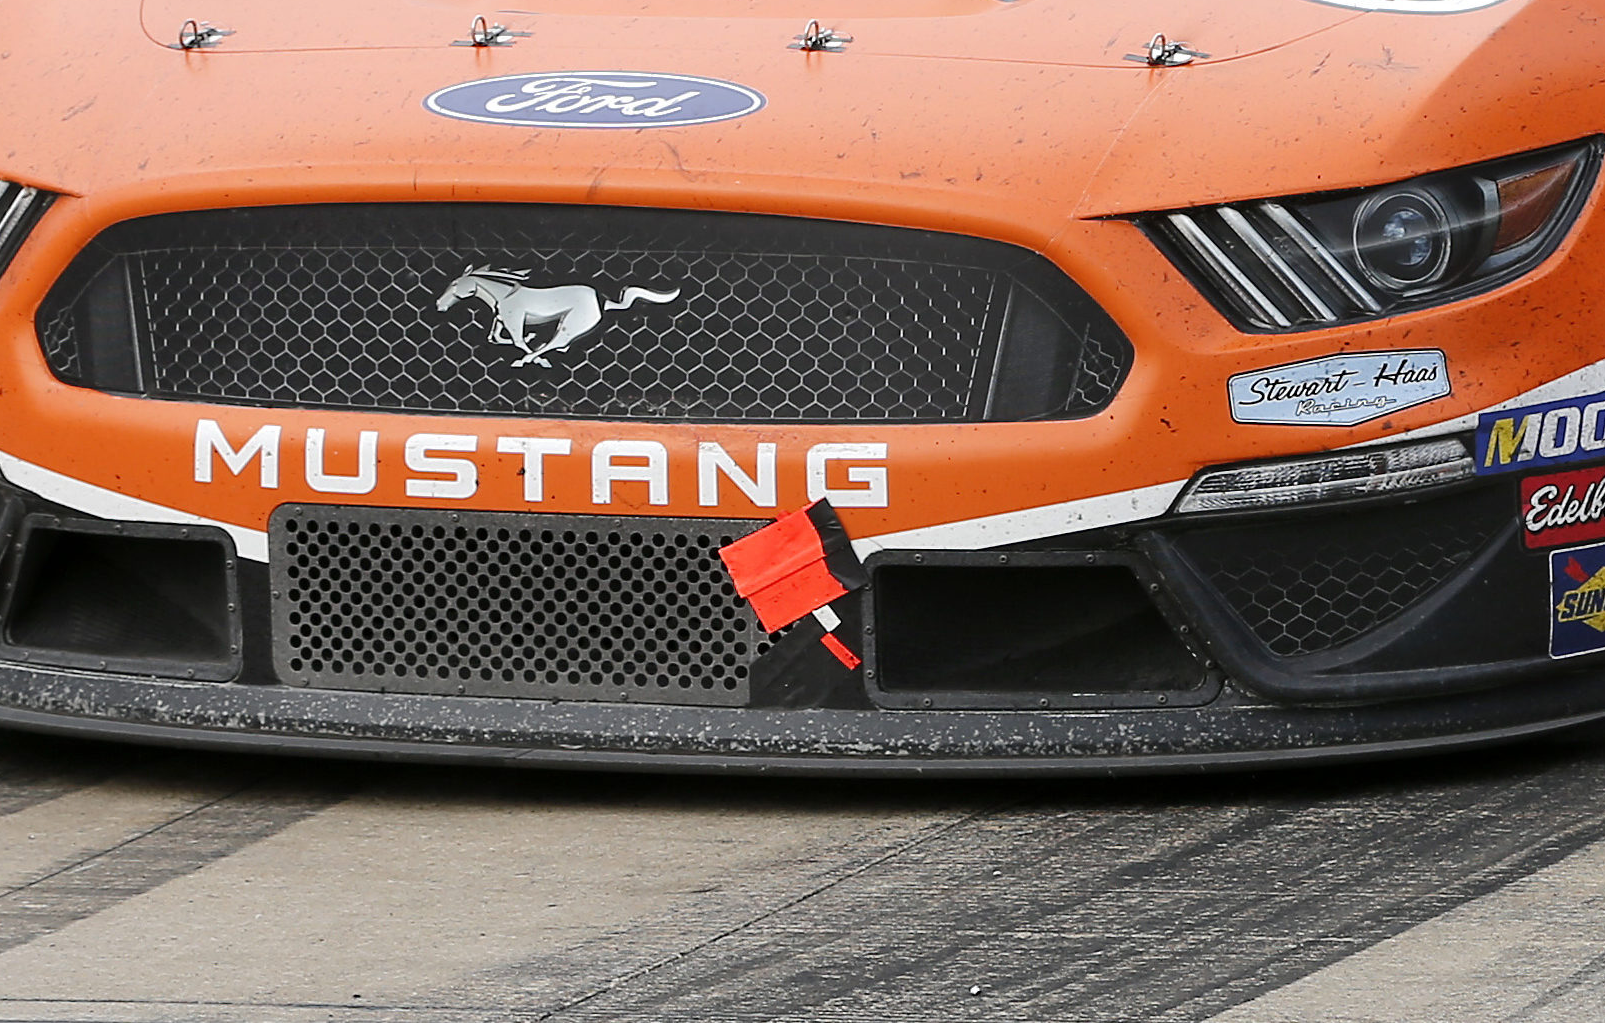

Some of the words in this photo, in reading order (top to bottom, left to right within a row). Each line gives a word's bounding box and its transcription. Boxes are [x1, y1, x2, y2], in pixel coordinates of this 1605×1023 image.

[473, 72, 699, 125] Ford
[1237, 369, 1352, 407] Stewart
[1372, 356, 1440, 388] Haas
[1294, 393, 1396, 417] Racing
[194, 418, 889, 509] MUSTANG
